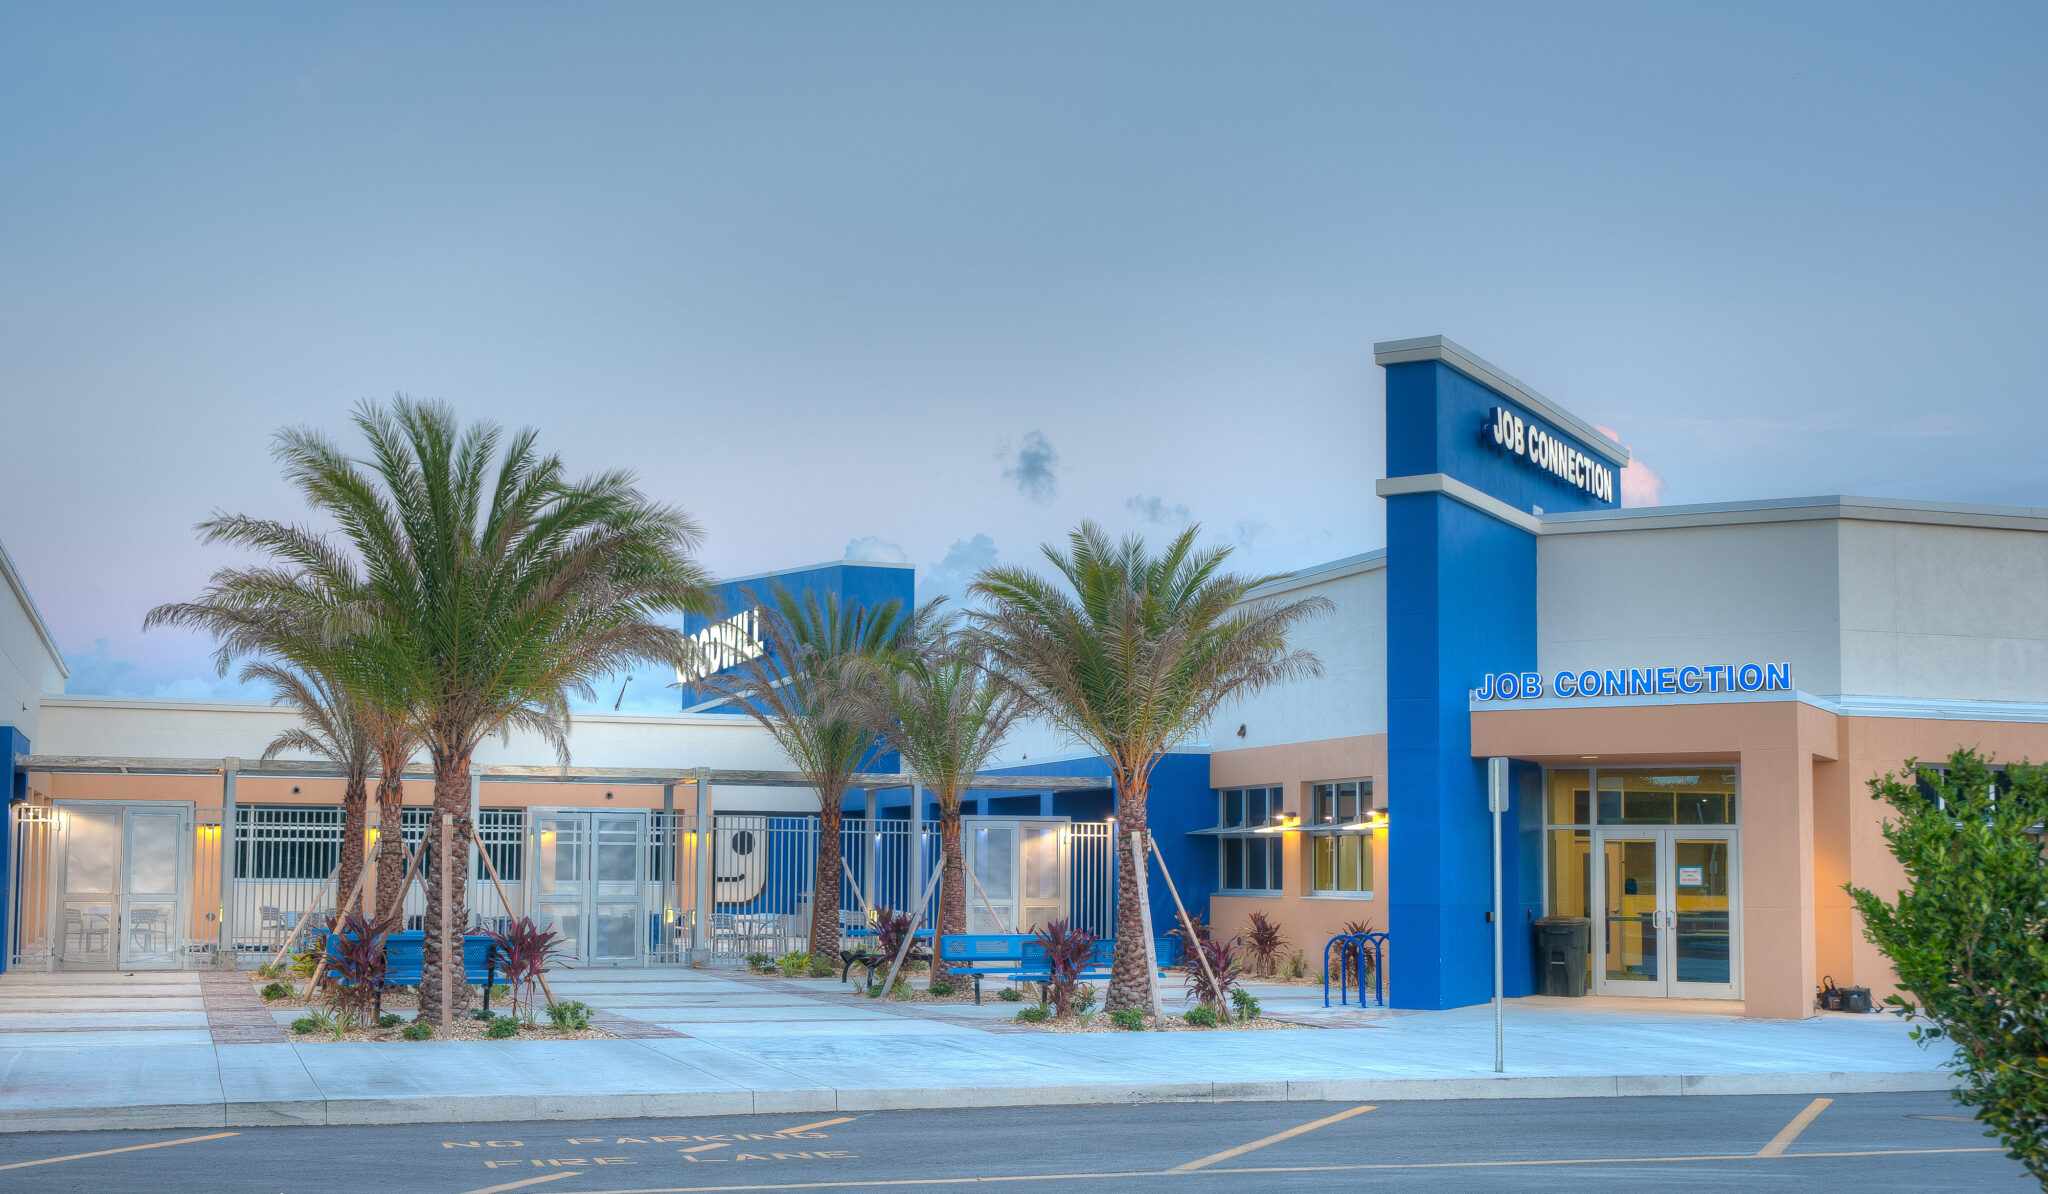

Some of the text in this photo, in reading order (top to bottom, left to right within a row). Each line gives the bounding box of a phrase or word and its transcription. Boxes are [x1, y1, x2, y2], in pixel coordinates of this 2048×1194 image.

[1494, 406, 1613, 504] JOB CONNECTION
[1475, 662, 1792, 701] JOB CONNECTION
[441, 1132, 829, 1149] NO PARKING
[484, 1150, 860, 1169] FIRE LANE
